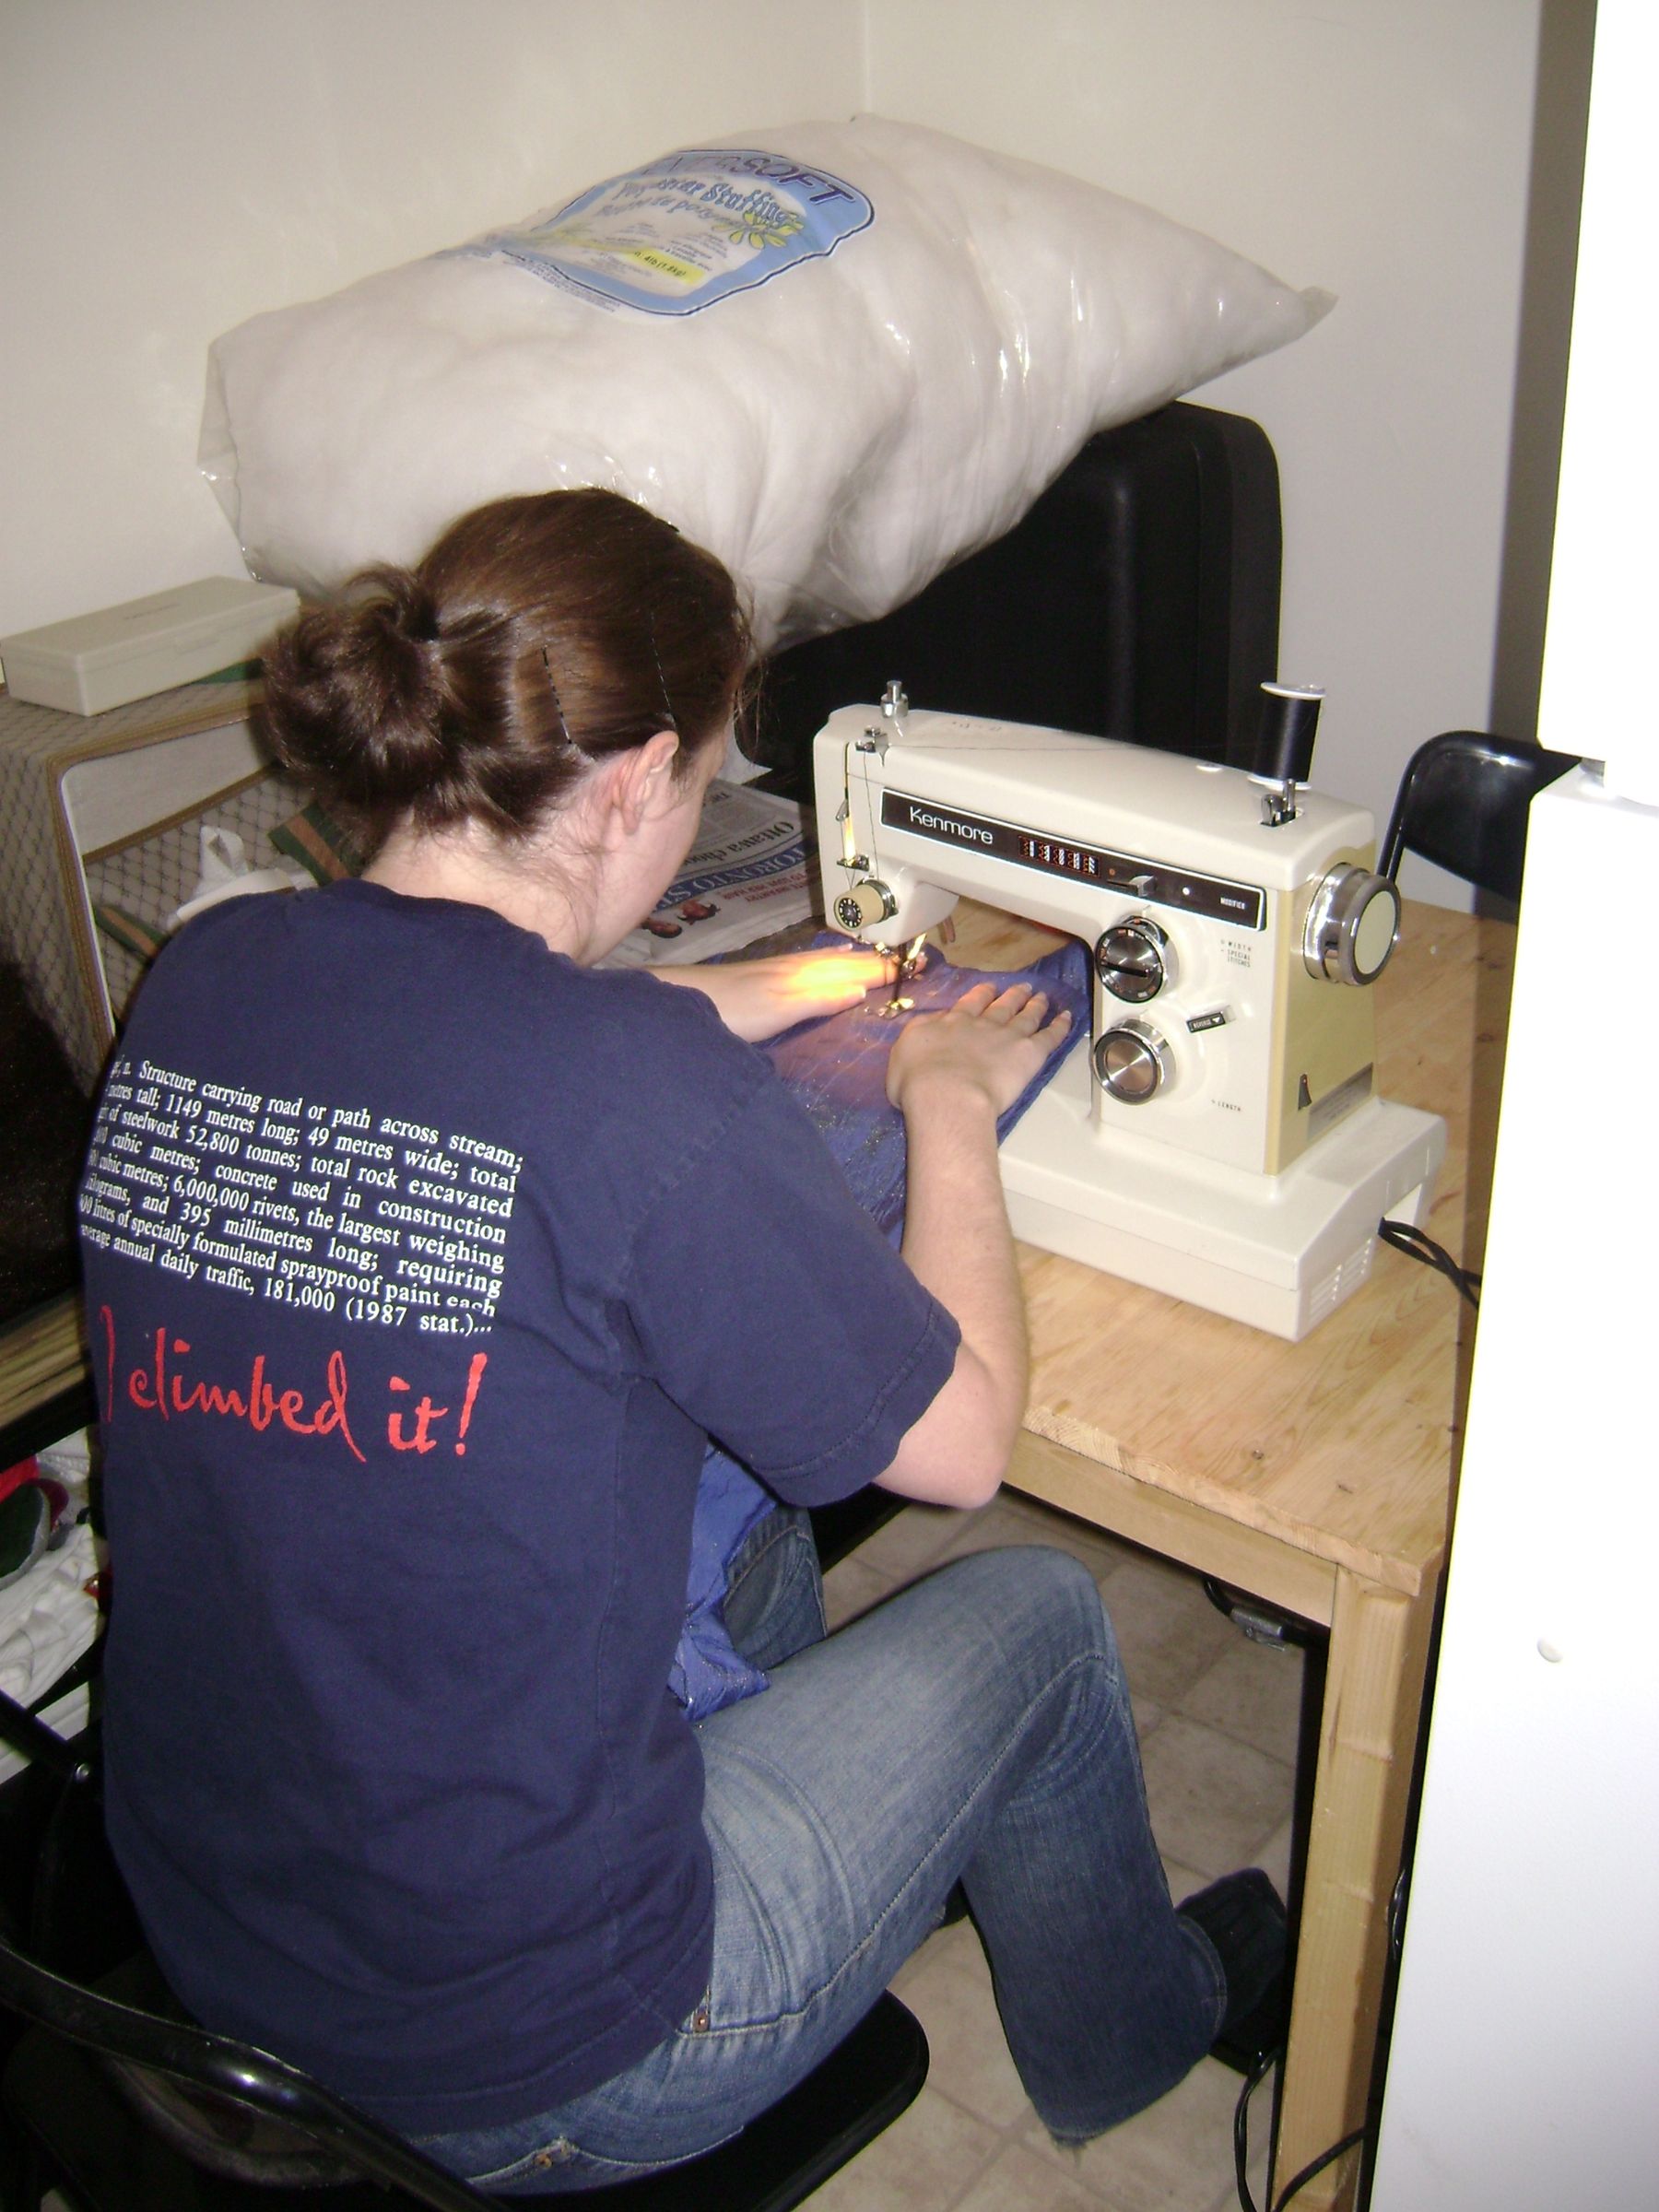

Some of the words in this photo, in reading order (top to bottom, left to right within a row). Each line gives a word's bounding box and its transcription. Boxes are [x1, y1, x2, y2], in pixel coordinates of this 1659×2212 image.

[692, 847, 806, 890] TORONTO
[727, 820, 794, 853] Ottawa
[910, 806, 994, 844] Kenmore
[122, 1109, 181, 1139] steelwork
[185, 1124, 240, 1155] 52,800
[245, 1144, 301, 1172] tonnes;
[311, 1156, 351, 1179] total
[357, 1167, 399, 1190] rock
[408, 1179, 514, 1218] excavated
[136, 1087, 161, 1111] tall;
[166, 1094, 202, 1118] 1149
[206, 1108, 255, 1134] metres
[261, 1118, 300, 1146] long;
[308, 1126, 330, 1147] 49
[335, 1135, 394, 1160] metres
[405, 1147, 459, 1180] wide;
[470, 1166, 517, 1193] total
[139, 1060, 196, 1092] Structure
[202, 1084, 263, 1113] carrying
[267, 1097, 303, 1117] road
[308, 1104, 327, 1121] or
[332, 1108, 371, 1129] path
[381, 1117, 440, 1145] across
[449, 1134, 524, 1173] stream;
[99, 1153, 122, 1174] cubic
[123, 1163, 170, 1193] metres;
[173, 1174, 250, 1211] 6,000,000
[252, 1197, 300, 1227] rivets,
[307, 1206, 335, 1230] the
[337, 1212, 401, 1246] largest
[409, 1234, 505, 1274] weighing
[112, 1132, 143, 1153] cubic
[150, 1144, 201, 1174] metres;
[215, 1163, 278, 1191] concrete
[291, 1181, 330, 1202] used
[342, 1185, 362, 1208] in
[378, 1199, 507, 1244] construction
[113, 1236, 156, 1263] annual
[160, 1249, 199, 1280] daily
[206, 1265, 255, 1296] traffic,
[265, 1277, 335, 1312] 181,000
[345, 1297, 407, 1327] (1987
[117, 1209, 133, 1228] of
[131, 1214, 190, 1250] specially
[193, 1231, 277, 1271] formulated
[281, 1257, 383, 1296] sprayproof
[385, 1283, 441, 1307] paint
[446, 1295, 496, 1318] each
[142, 1195, 170, 1215] and
[180, 1202, 212, 1227] 395
[223, 1218, 313, 1253] millimetres
[327, 1237, 380, 1272] long;
[396, 1257, 503, 1299] requiring
[128, 1327, 367, 1463] climbed
[388, 1352, 488, 1455] it!
